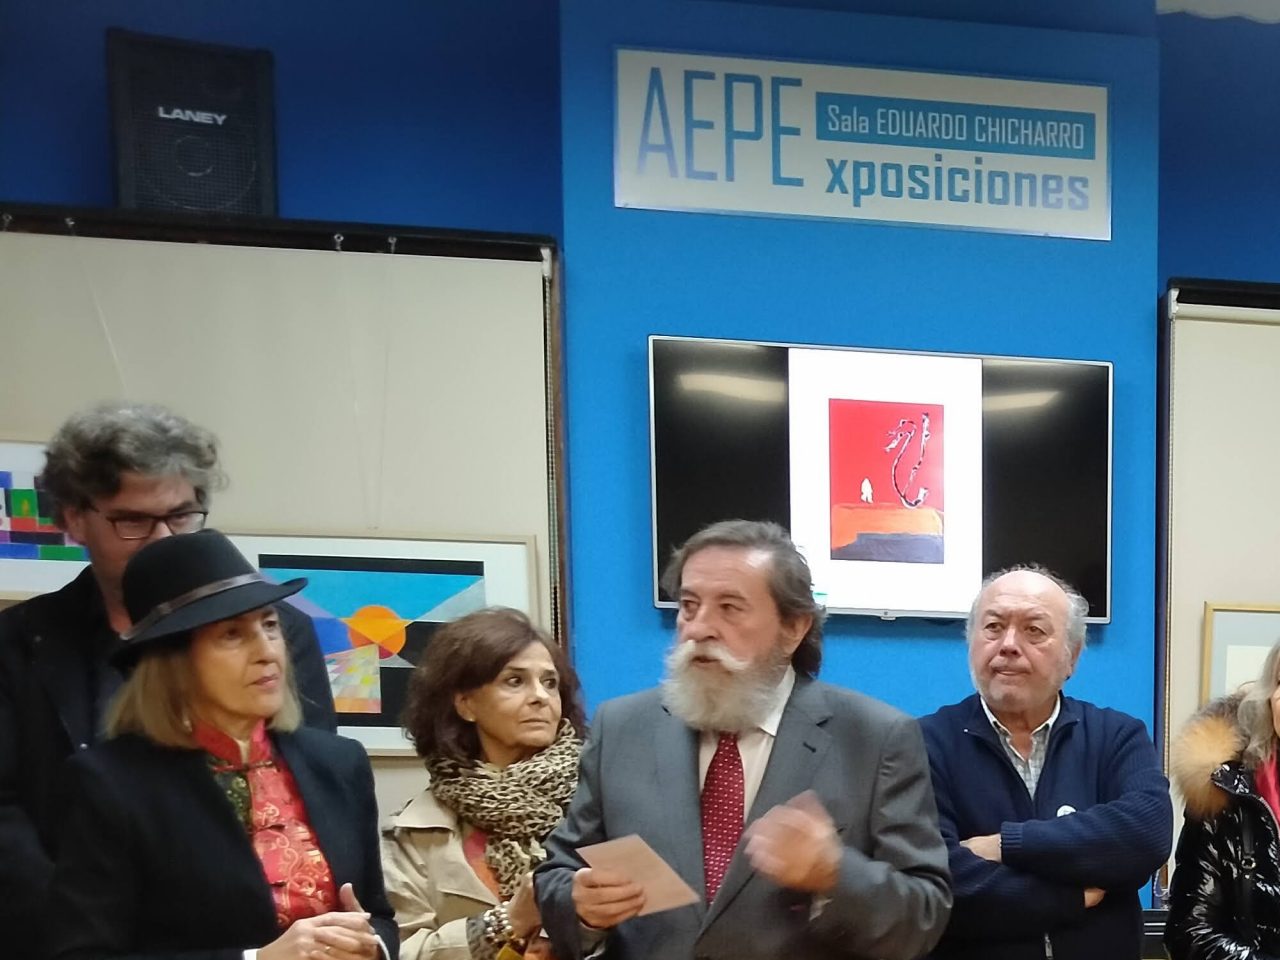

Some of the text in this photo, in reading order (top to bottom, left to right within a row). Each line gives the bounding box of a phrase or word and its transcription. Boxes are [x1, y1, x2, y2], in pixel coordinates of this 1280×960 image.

[157, 106, 227, 125] LANEY
[636, 66, 805, 188] AEPE
[827, 105, 1085, 150] Sala EDUARDO CHICHARRO
[824, 153, 1091, 211] xposiciones
